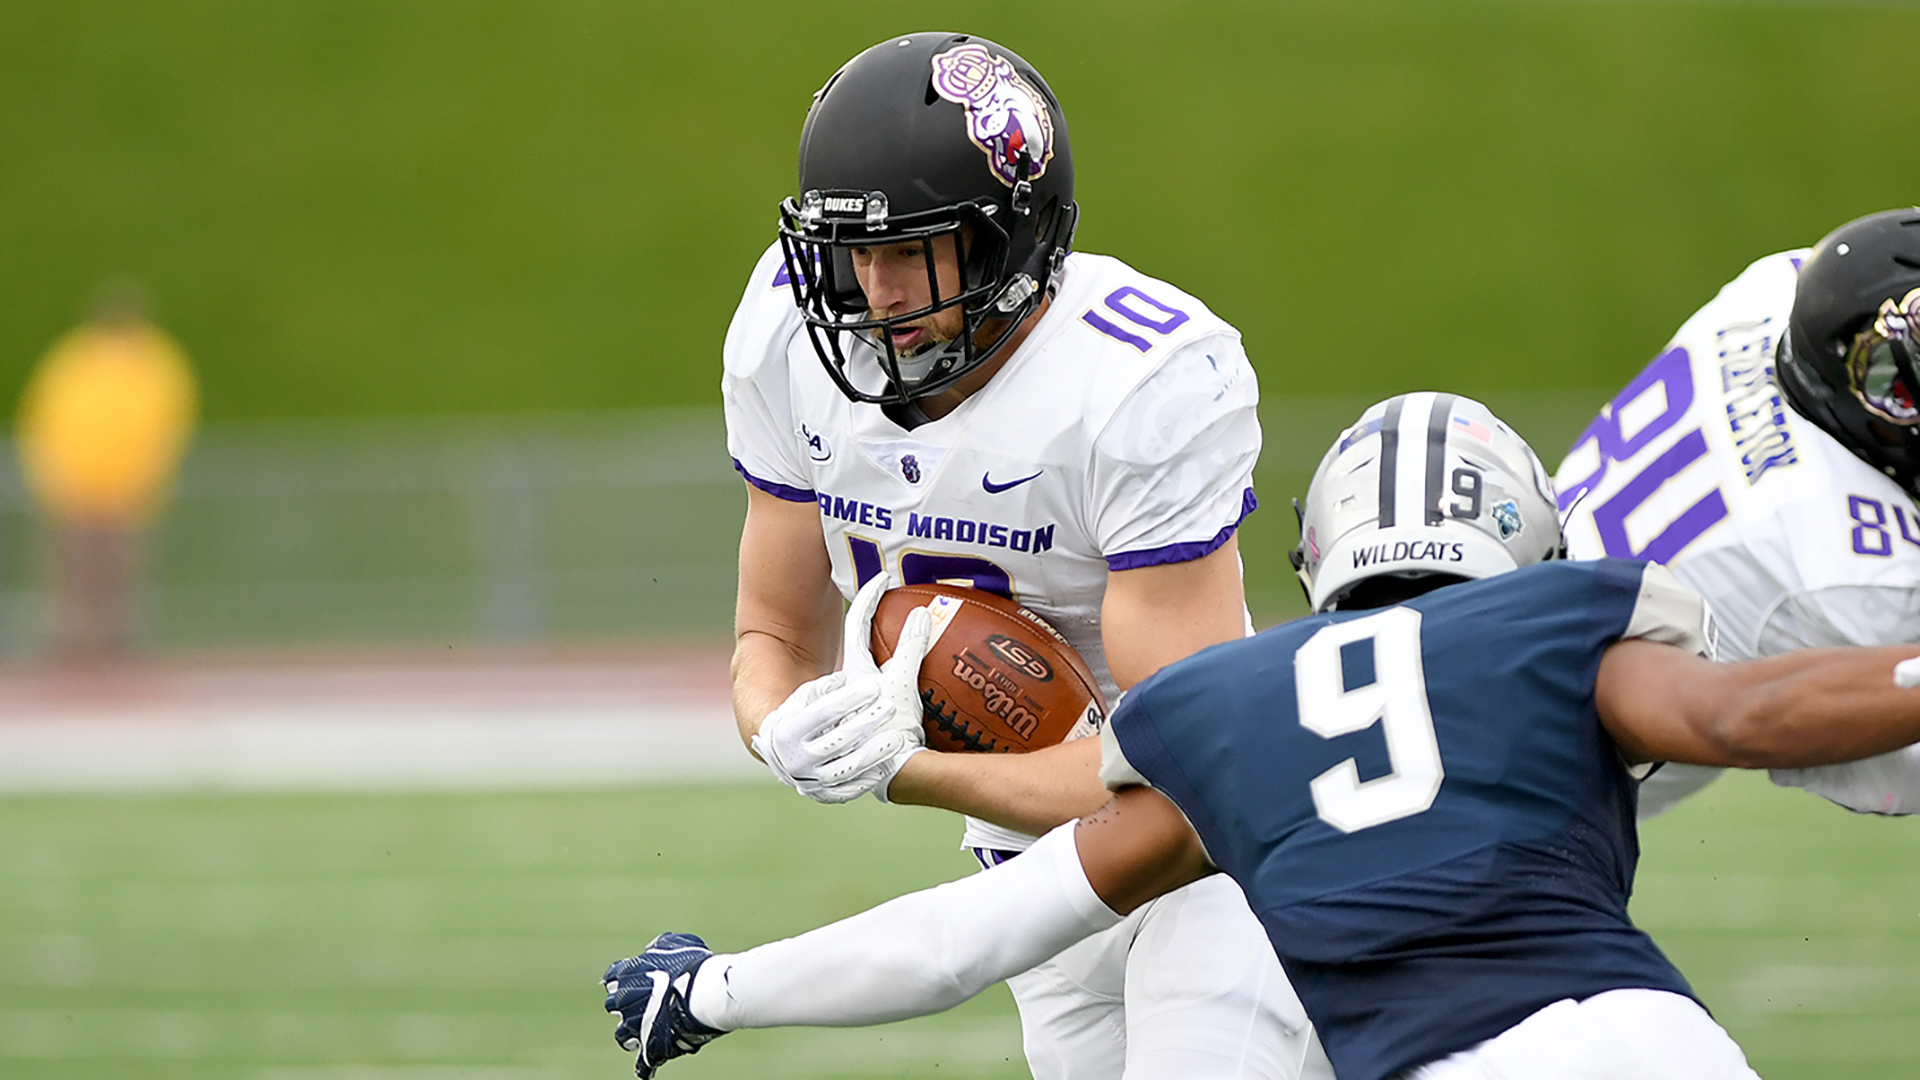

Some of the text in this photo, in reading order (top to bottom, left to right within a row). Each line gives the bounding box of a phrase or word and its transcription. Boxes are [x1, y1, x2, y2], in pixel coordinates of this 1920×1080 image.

[824, 197, 865, 212] DUKES
[1080, 285, 1191, 357] 10
[817, 491, 1056, 555] AMES MADISON
[1449, 467, 1483, 521] 9
[1352, 540, 1464, 569] WILDCATS
[989, 638, 1049, 681] GST
[951, 657, 1040, 741] Wilson
[1294, 605, 1446, 834] 9
